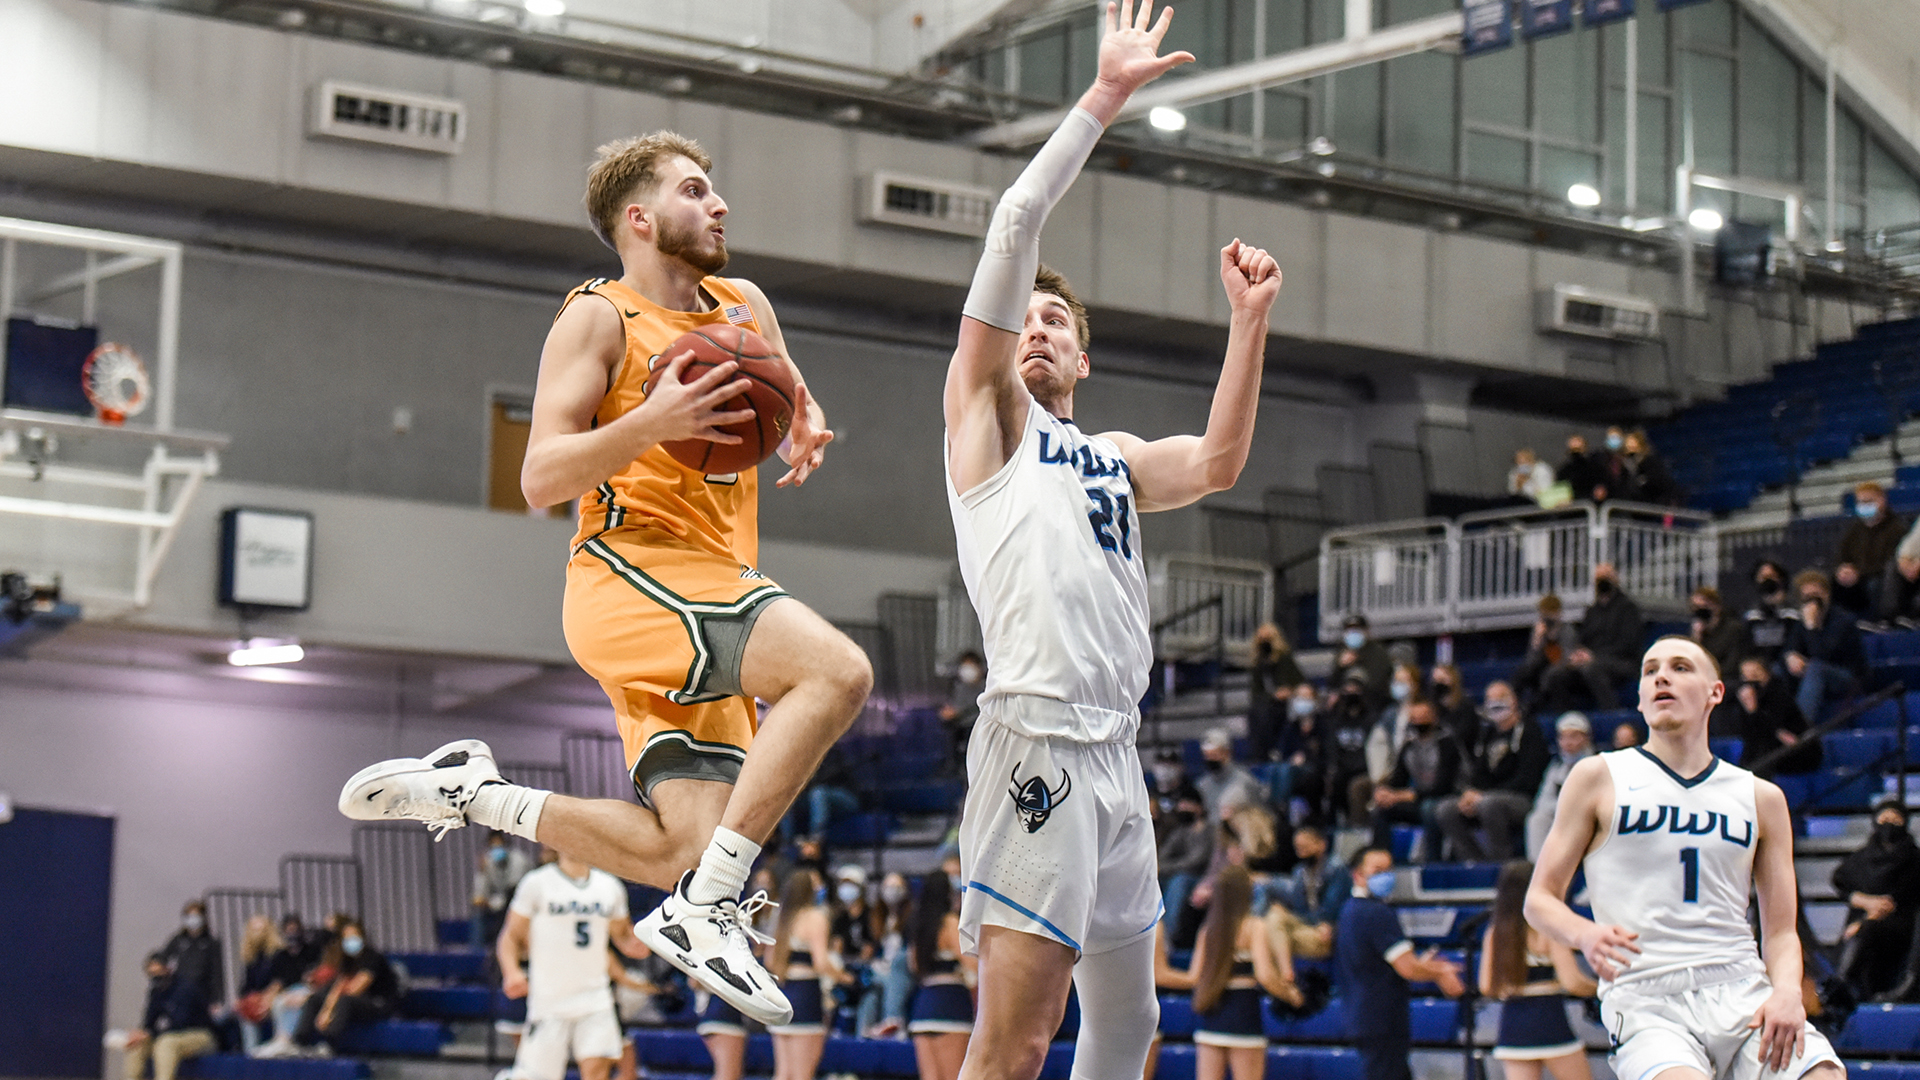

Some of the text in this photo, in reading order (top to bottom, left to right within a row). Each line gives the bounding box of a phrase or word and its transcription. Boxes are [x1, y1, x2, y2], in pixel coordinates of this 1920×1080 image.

[1085, 486, 1132, 561] 21
[1617, 804, 1752, 849] WWU
[1679, 846, 1699, 904] 1
[575, 921, 590, 947] 5
